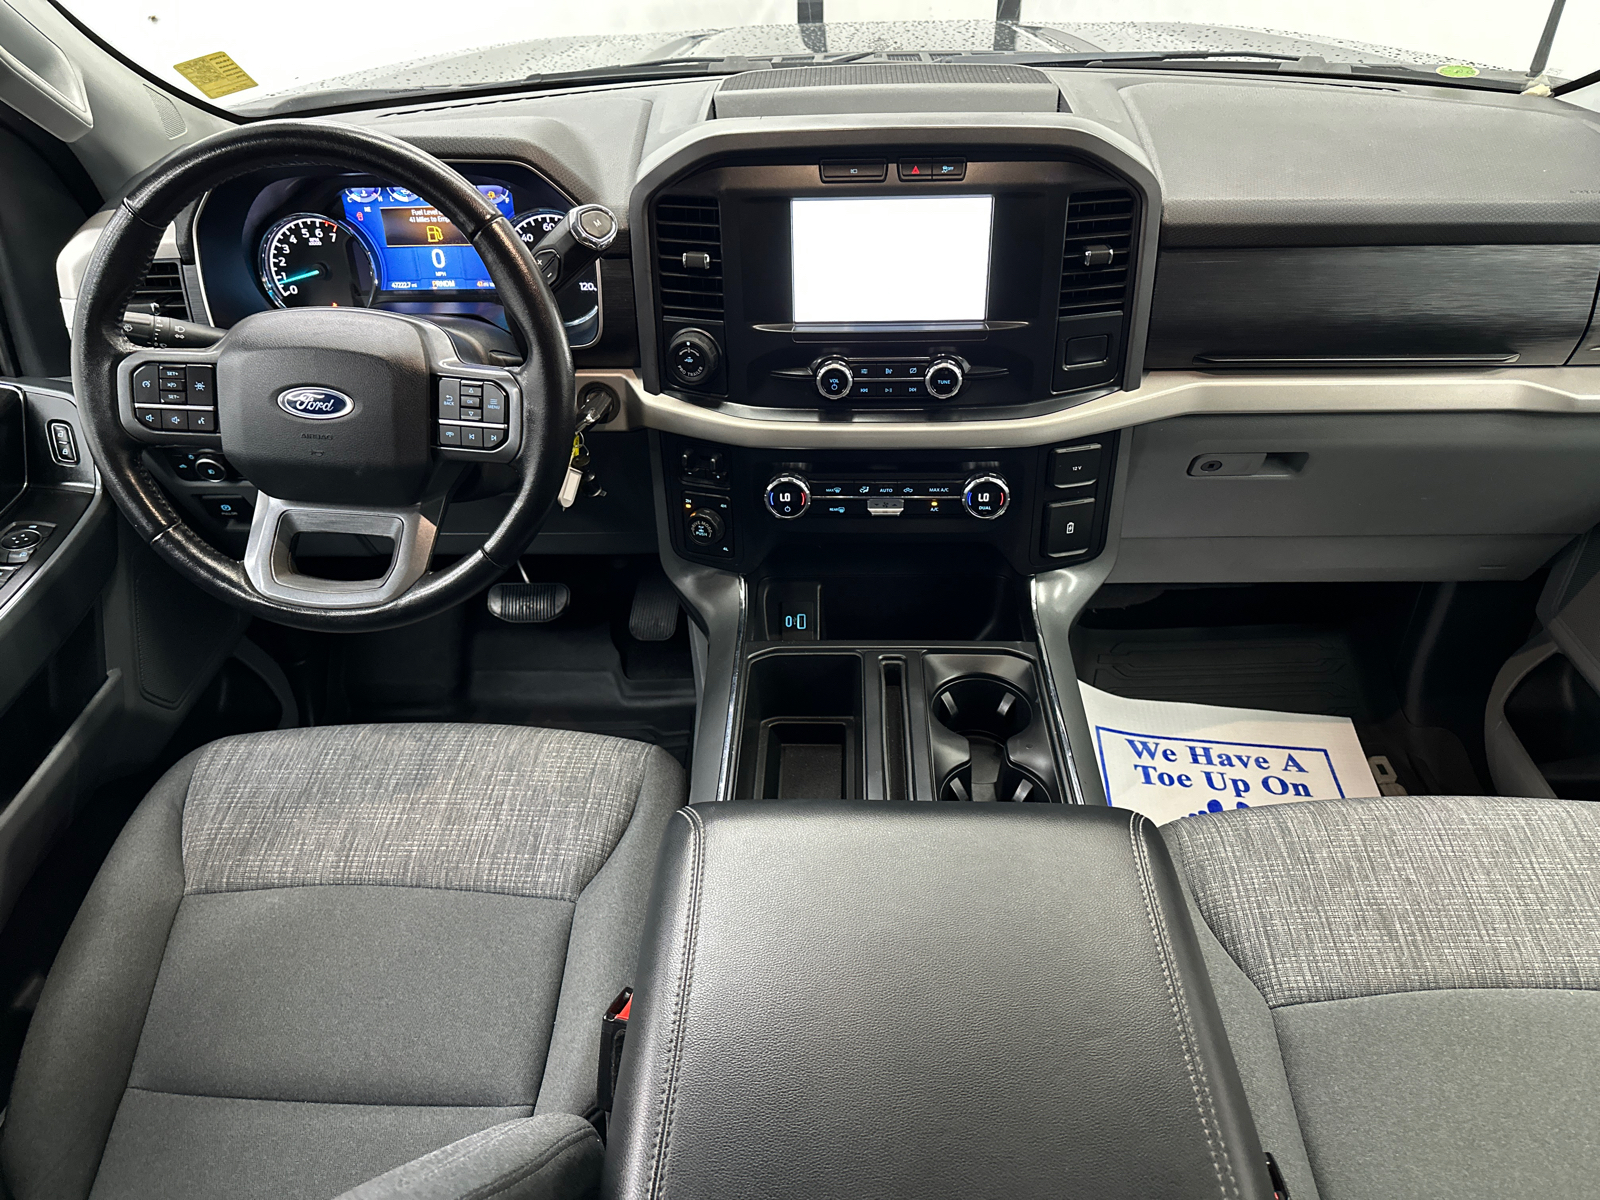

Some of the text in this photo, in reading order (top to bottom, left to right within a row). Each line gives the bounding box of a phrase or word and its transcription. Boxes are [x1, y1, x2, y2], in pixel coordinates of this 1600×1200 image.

[542, 222, 555, 231] 60
[593, 219, 602, 228] M
[301, 228, 310, 238] 5
[315, 228, 323, 238] 6
[329, 232, 337, 242] 7
[521, 233, 534, 242] 40
[289, 234, 298, 244] 4
[281, 244, 290, 254] 3
[278, 257, 286, 267] 2
[431, 248, 446, 269] 0
[281, 272, 286, 281] 1
[289, 285, 299, 295] 0
[579, 282, 594, 292] 120
[677, 365, 687, 375] PRO
[287, 393, 335, 412] Ford
[779, 492, 791, 502] LO
[978, 493, 990, 502] LO
[1125, 738, 1310, 774] We Have A
[1133, 764, 1314, 799] Toe Up On
